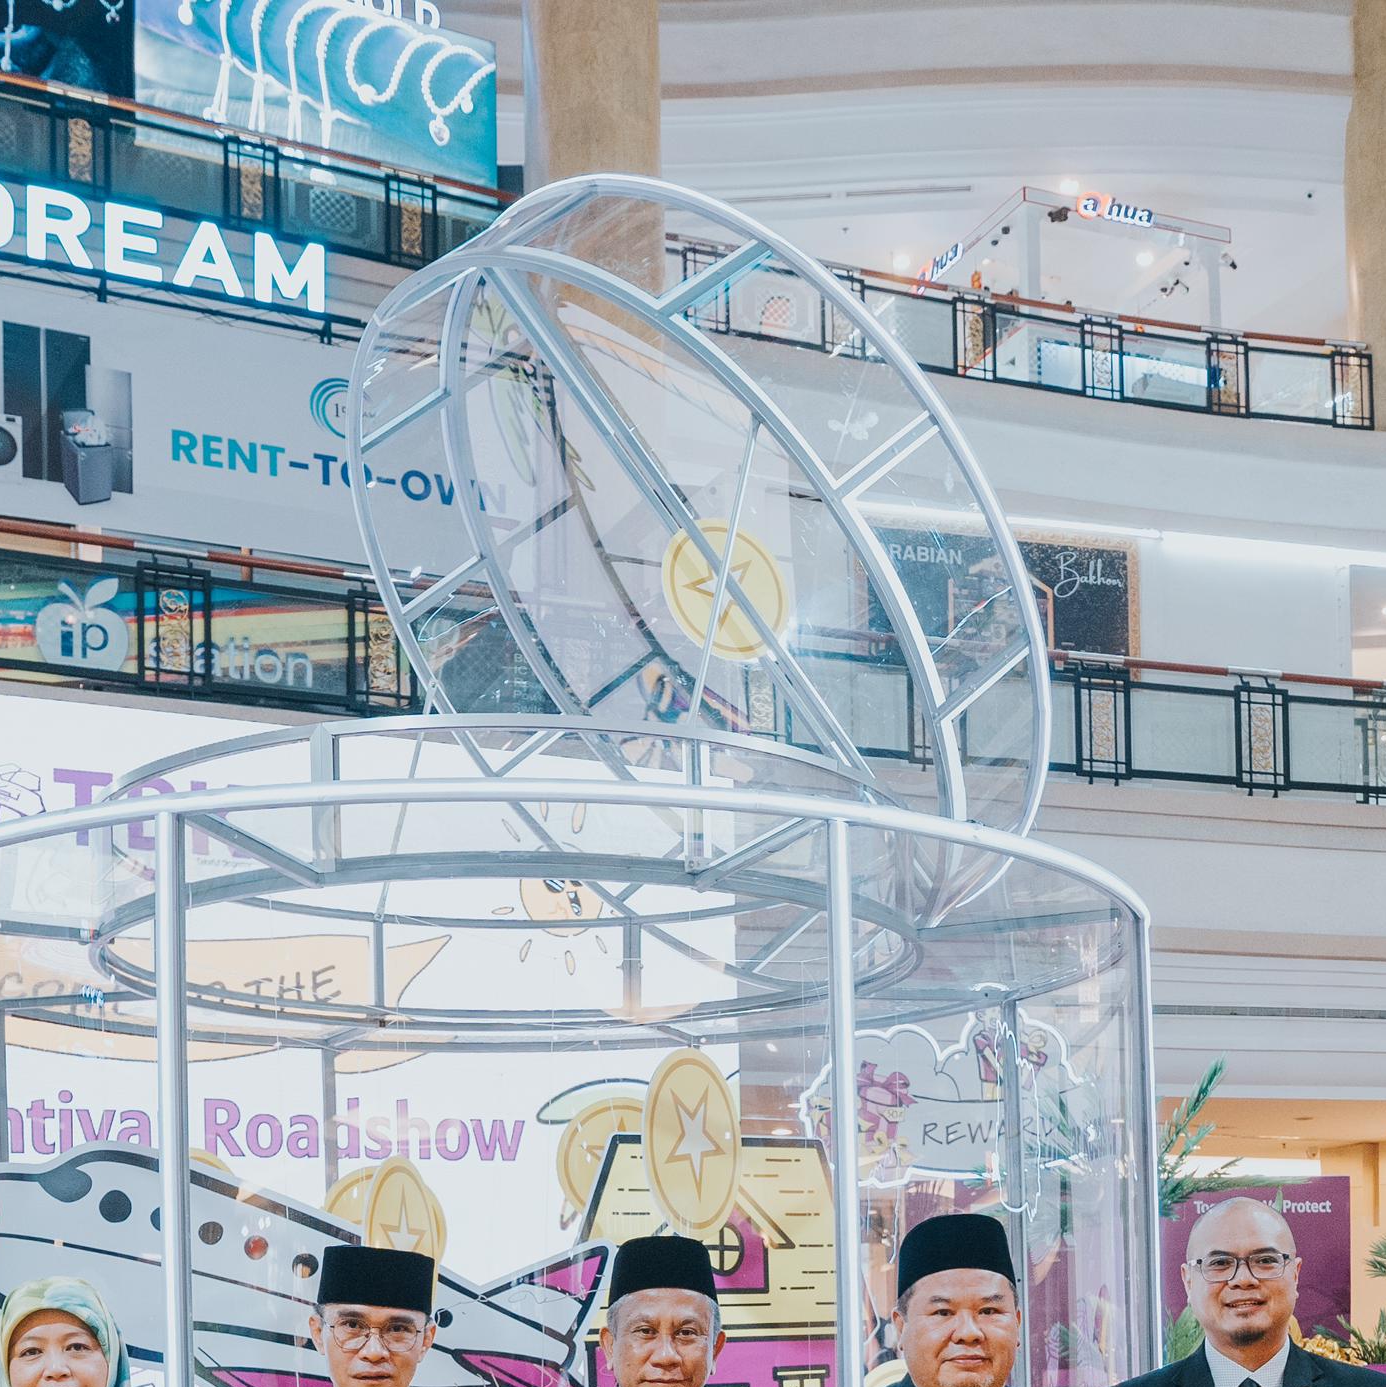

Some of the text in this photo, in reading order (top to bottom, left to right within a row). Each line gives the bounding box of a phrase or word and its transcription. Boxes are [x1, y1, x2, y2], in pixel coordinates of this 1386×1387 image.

[883, 543, 963, 566] RABIAN
[60, 619, 109, 659] ip
[203, 1097, 524, 1165] Roadshow
[1282, 1199, 1332, 1214] Protect
